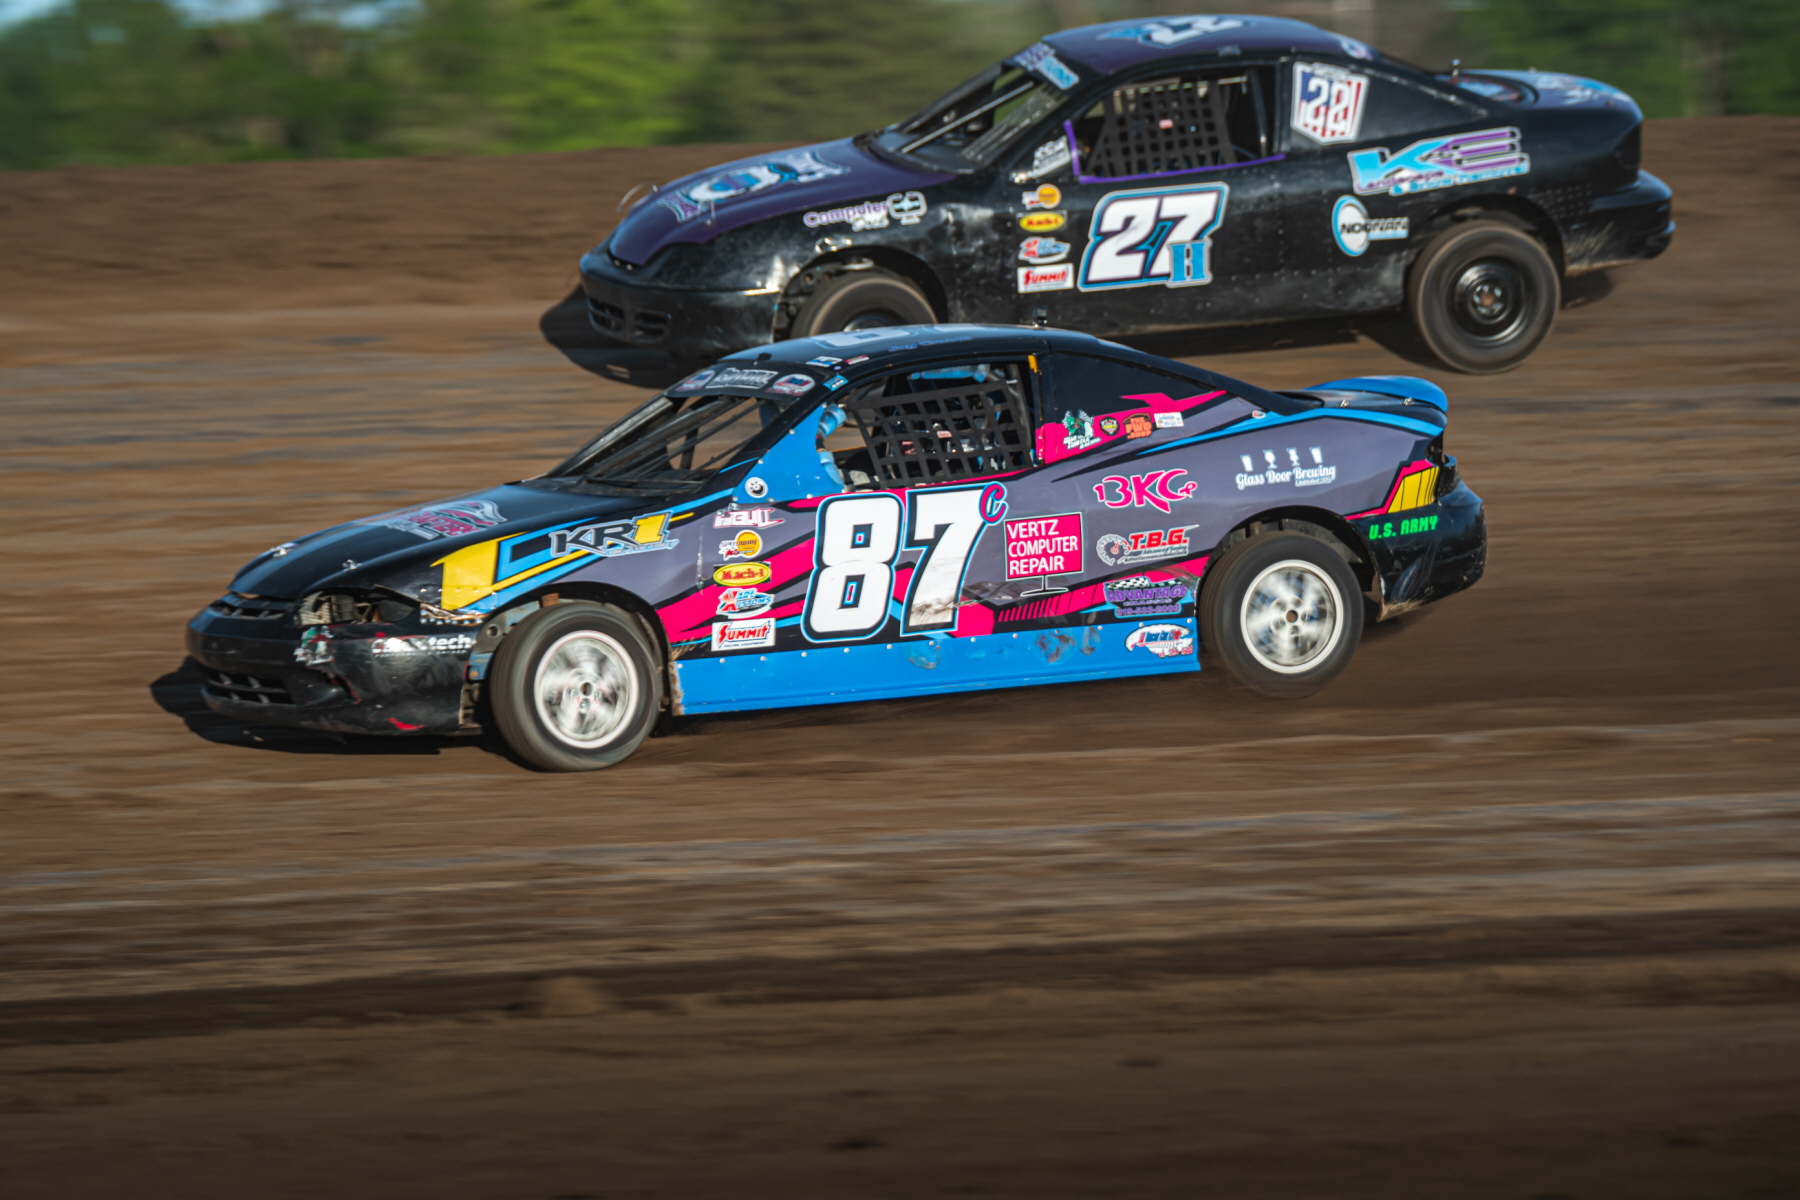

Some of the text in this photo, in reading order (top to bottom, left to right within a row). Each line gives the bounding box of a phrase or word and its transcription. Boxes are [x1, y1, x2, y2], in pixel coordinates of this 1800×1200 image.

[1125, 421, 1153, 434] FWD
[1235, 464, 1336, 490] Glass Door Brewing
[551, 511, 670, 557] KR1
[1006, 518, 1060, 539] VERTZ
[1368, 515, 1438, 540] U.S. ARMY
[1008, 535, 1079, 558] COMPUTER
[1130, 528, 1189, 551] T.B.G.
[1009, 555, 1065, 576] REPAIR
[1107, 584, 1188, 603] ADVANTAGE
